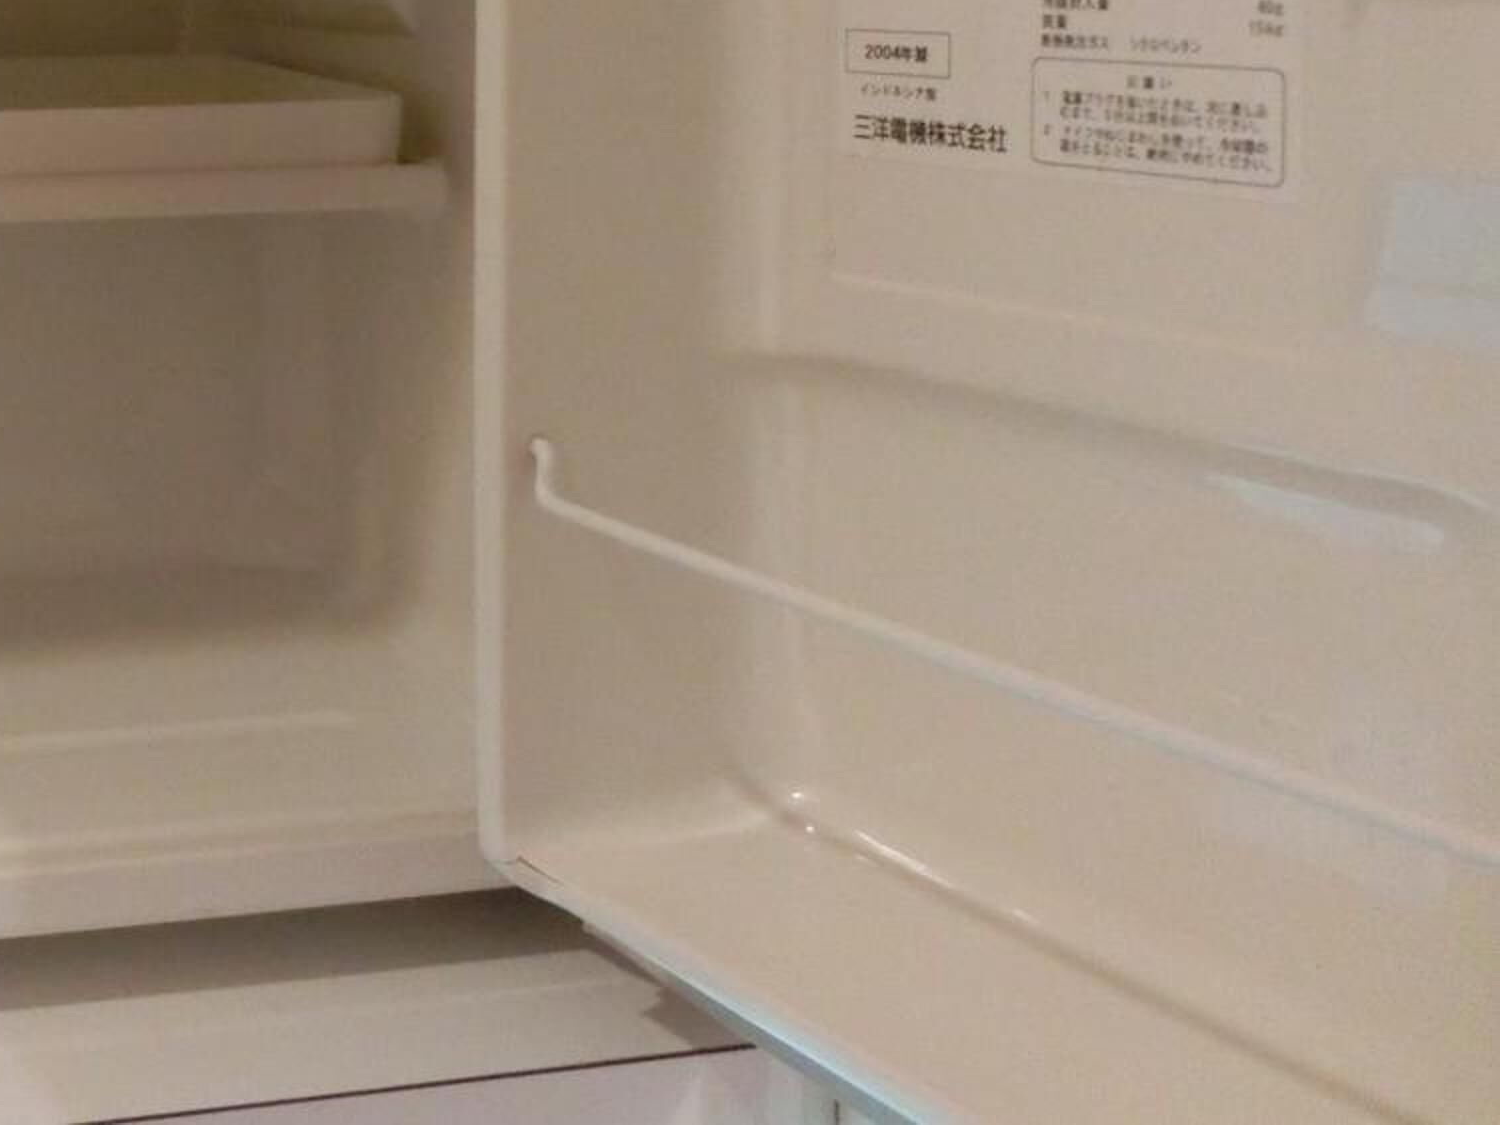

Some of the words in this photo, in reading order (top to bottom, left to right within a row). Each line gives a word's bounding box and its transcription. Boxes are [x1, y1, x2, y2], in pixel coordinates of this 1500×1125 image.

[853, 114, 1008, 153] 三洋電機株式会社
